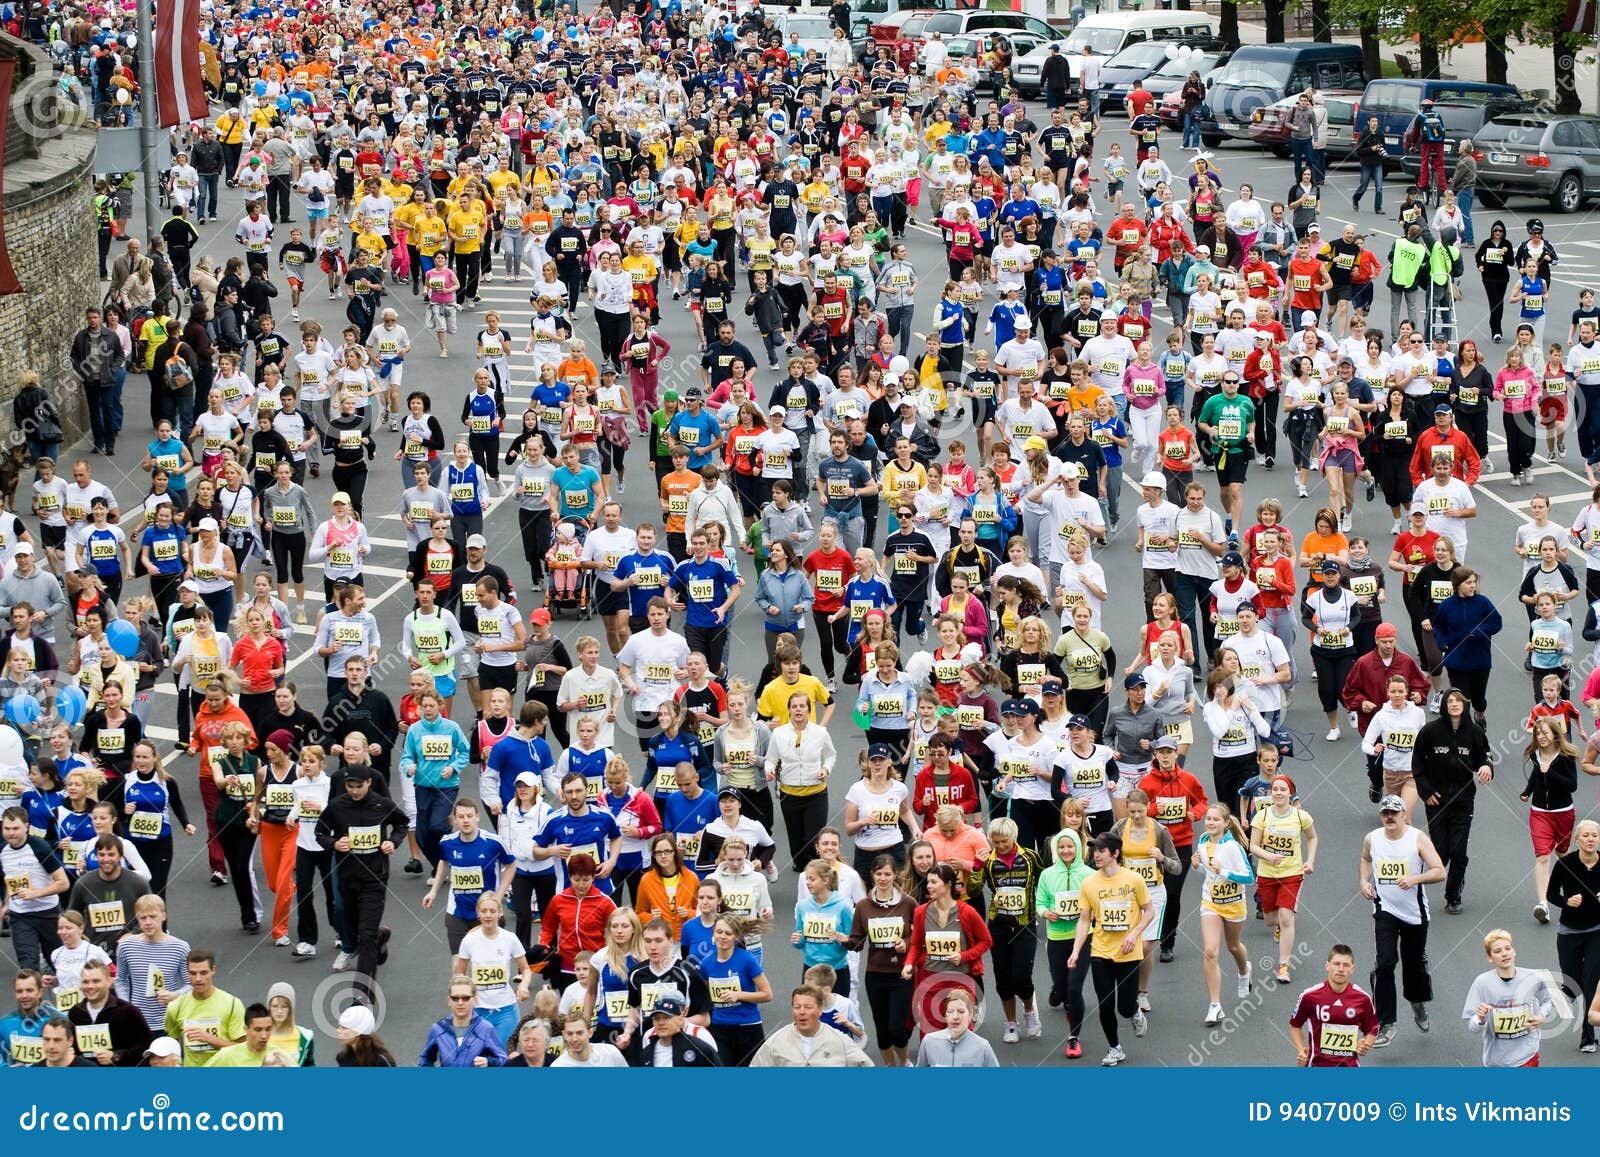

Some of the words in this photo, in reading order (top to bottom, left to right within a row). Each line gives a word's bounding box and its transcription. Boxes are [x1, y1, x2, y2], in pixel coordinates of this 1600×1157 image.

[768, 455, 785, 464] 5122
[898, 480, 915, 490] 5150
[671, 500, 687, 510] 5531
[1430, 498, 1448, 509] 6117
[276, 511, 293, 521] 5888
[974, 510, 994, 519] 10764
[95, 545, 113, 554] 5708
[158, 546, 175, 555] 6849
[1529, 543, 1538, 552] 59
[431, 558, 449, 569] 6277
[898, 560, 915, 569] 6616
[640, 573, 659, 583] 5918
[820, 576, 839, 586] 5844
[968, 572, 977, 582] 42
[692, 586, 711, 596] 5919
[1354, 583, 1373, 592] 5951
[465, 590, 477, 599] 55
[481, 621, 498, 630] 5904
[1220, 622, 1239, 631] 5848
[339, 628, 360, 639] 5906
[1323, 634, 1342, 643] 6841
[419, 636, 438, 646] 5903
[1535, 637, 1554, 646] 6259
[1077, 655, 1097, 665] 6498
[198, 663, 217, 673] 5431
[649, 667, 669, 677] 5100
[938, 666, 959, 677] 5943
[584, 694, 603, 704] 612
[878, 700, 900, 711] 6054
[100, 736, 121, 746] 5877
[1390, 733, 1412, 744] 9173
[426, 742, 448, 753] 5562
[1078, 769, 1100, 780] 6843
[587, 783, 599, 794] 21
[271, 793, 293, 802] 5883
[1164, 804, 1183, 816] 655
[879, 811, 895, 822] 162
[134, 819, 157, 830] 8866
[354, 834, 377, 846] 6442
[1268, 835, 1292, 848] 5435
[686, 842, 698, 853] 49
[1130, 866, 1153, 878] 405
[1381, 864, 1406, 876] 6391
[454, 875, 480, 885] 10900
[1213, 883, 1238, 896] 5429
[95, 911, 120, 923] 5107
[1104, 910, 1126, 922] 5445
[873, 927, 900, 938] 10374
[931, 941, 956, 952] 5149
[477, 969, 504, 981] 5540
[1316, 1005, 1329, 1021] 16
[1499, 1015, 1525, 1031] 7722
[82, 1035, 107, 1048] 7146
[1325, 1031, 1352, 1048] 7725
[16, 1045, 42, 1060] 7145
